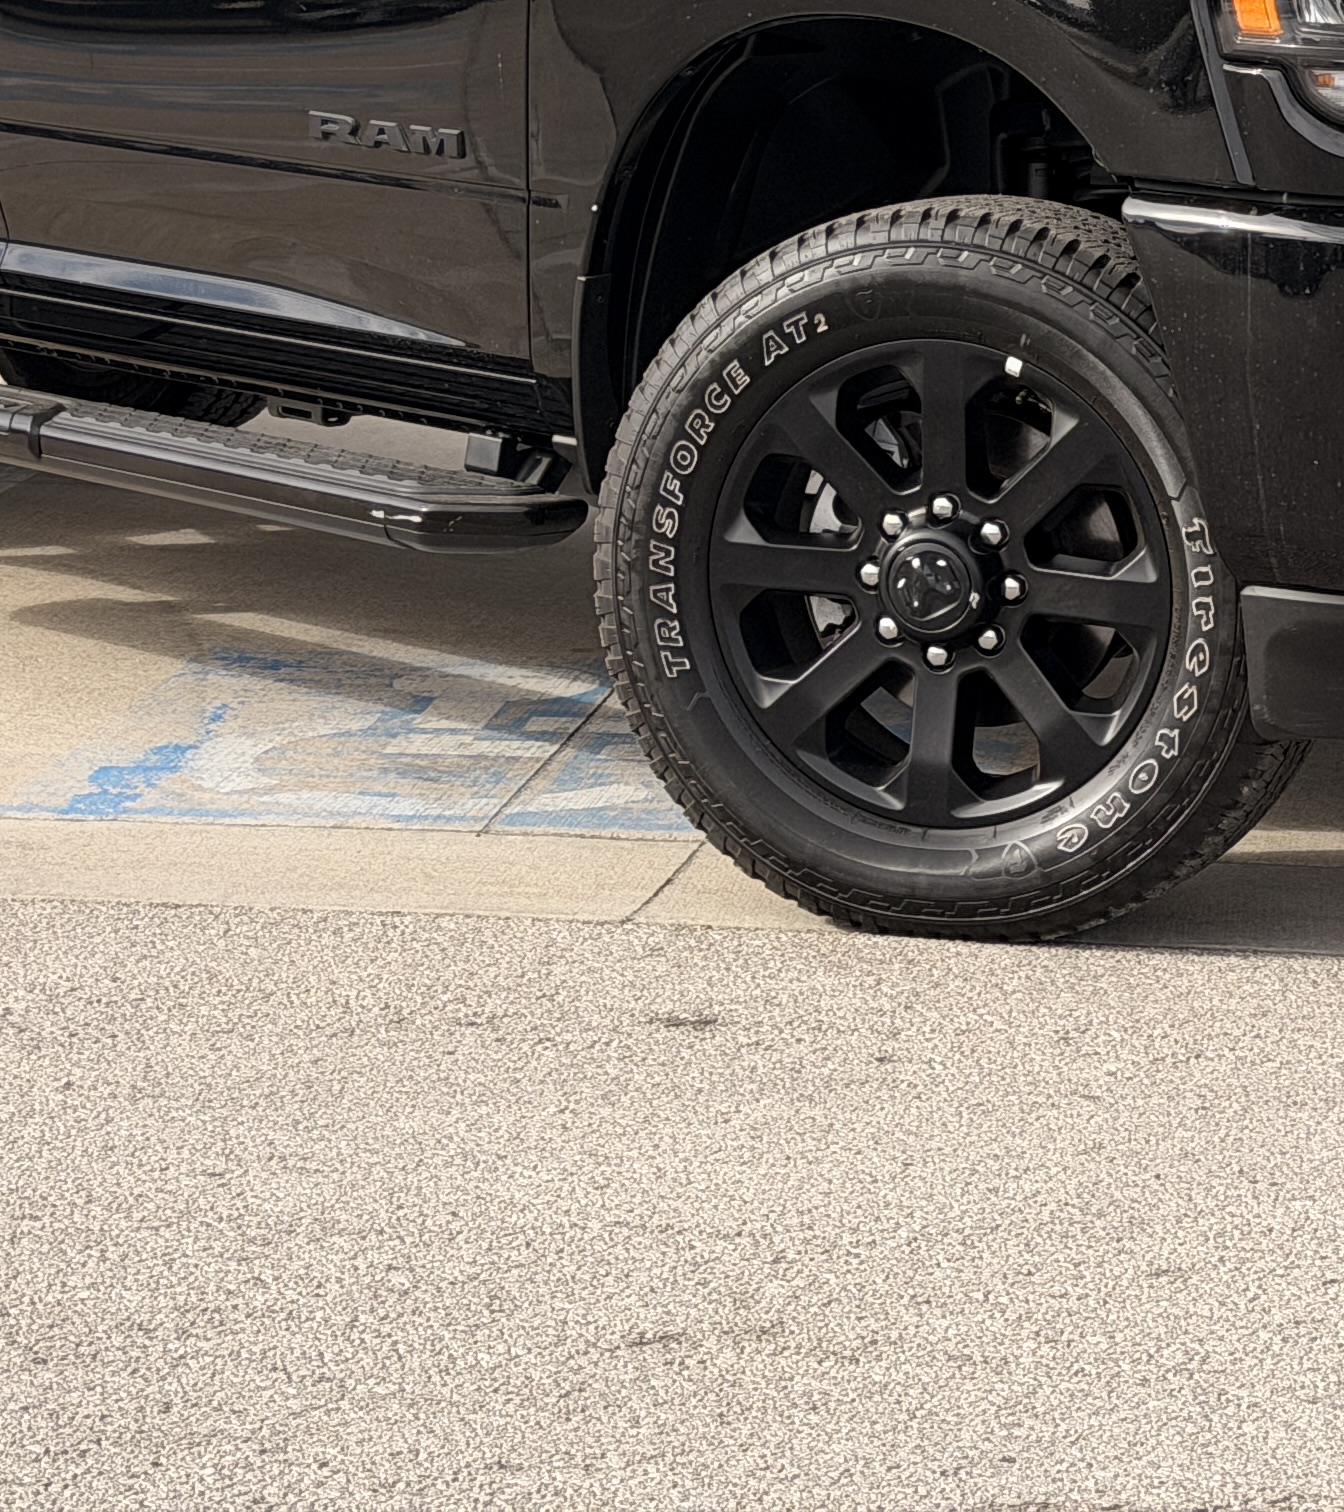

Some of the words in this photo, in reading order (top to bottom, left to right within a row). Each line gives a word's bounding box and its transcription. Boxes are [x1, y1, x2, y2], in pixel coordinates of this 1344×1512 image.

[308, 110, 467, 159] RAM
[649, 358, 751, 678] TRANSFORCE
[1056, 517, 1215, 853] Firestone
